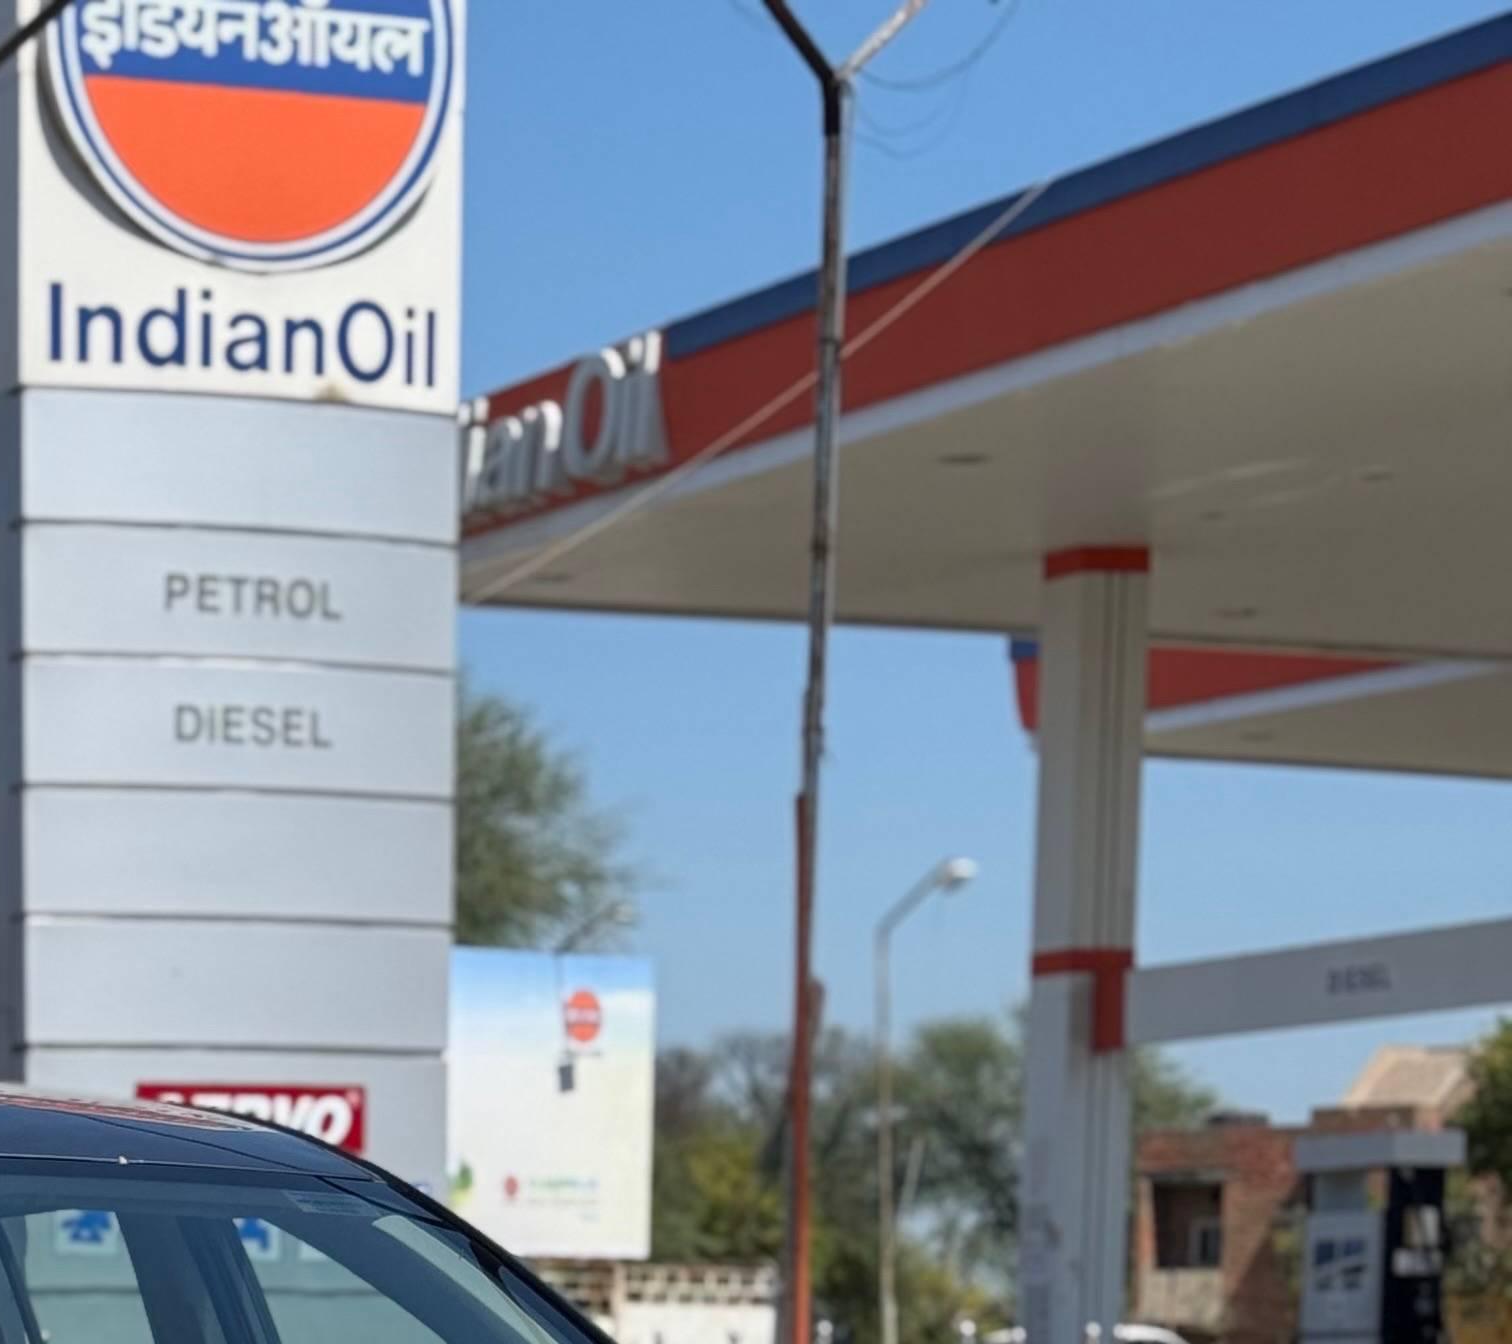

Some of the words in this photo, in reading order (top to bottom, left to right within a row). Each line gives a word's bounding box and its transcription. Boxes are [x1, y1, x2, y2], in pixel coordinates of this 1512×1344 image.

[49, 283, 436, 388] IndianOil
[163, 573, 342, 620] PETROL
[174, 704, 331, 748] DIESEL
